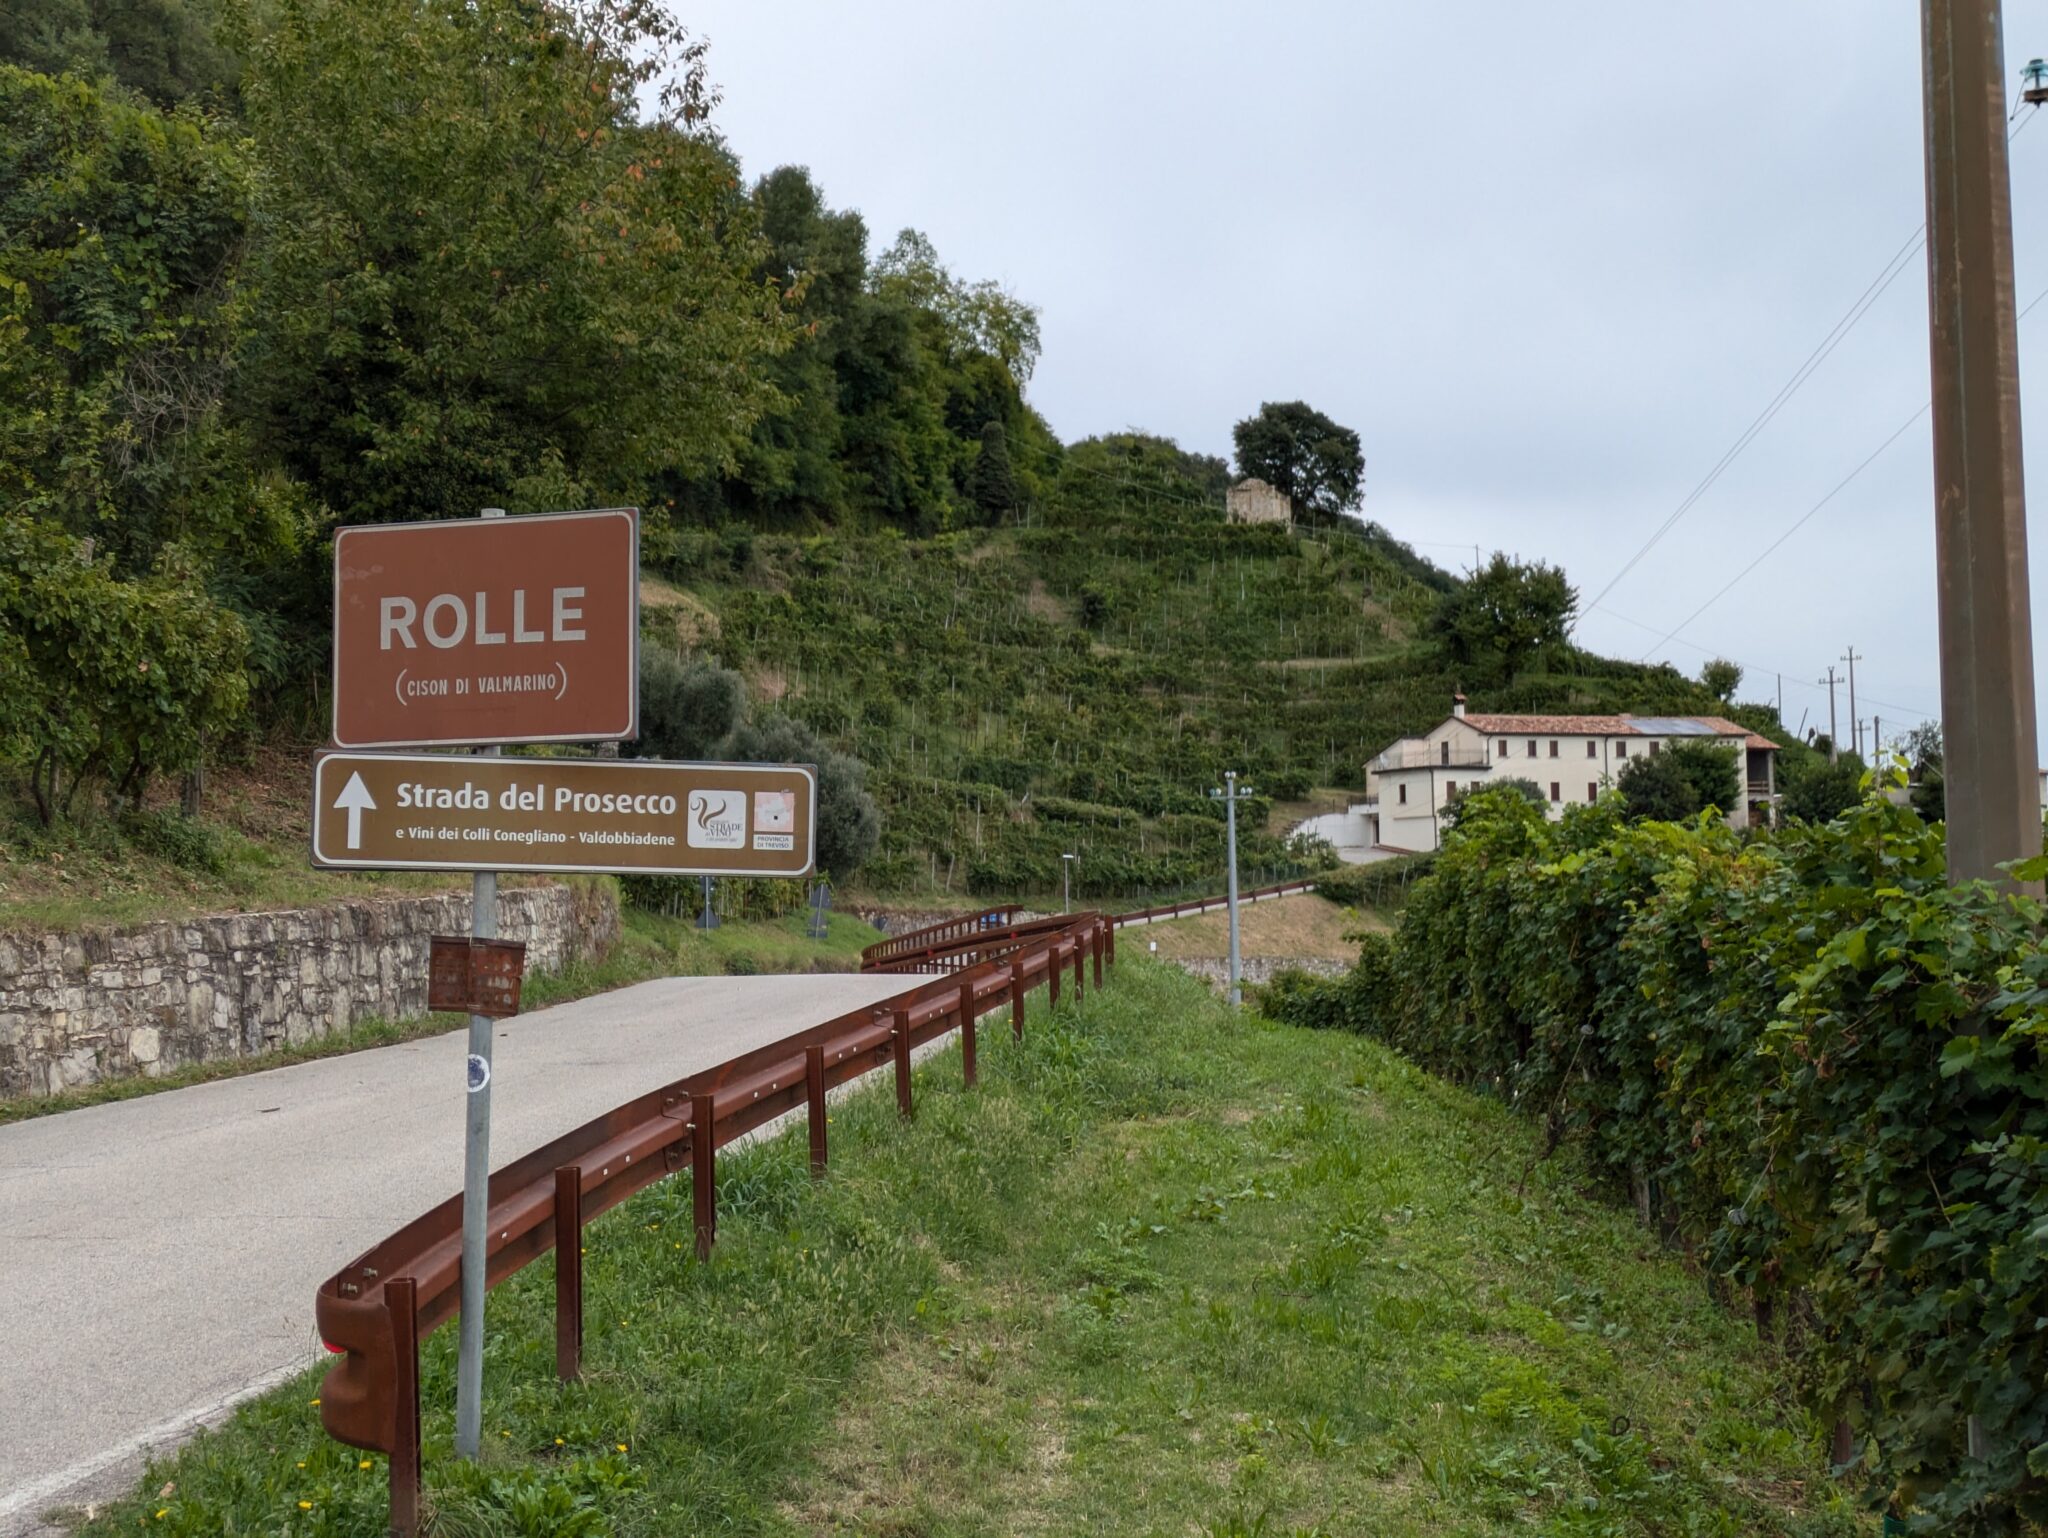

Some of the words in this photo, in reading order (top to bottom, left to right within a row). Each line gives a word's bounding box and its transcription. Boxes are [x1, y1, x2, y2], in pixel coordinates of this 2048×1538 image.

[380, 587, 586, 650] ROLLE
[455, 678, 469, 694] DI
[396, 782, 489, 809] Strada
[499, 783, 544, 811] del
[554, 788, 677, 815] Prosecco
[395, 828, 404, 839] e
[408, 827, 434, 840] Vini
[438, 827, 459, 840] dei
[462, 828, 490, 841] Colli
[493, 829, 566, 845] Conegliano
[578, 831, 675, 846] Valdobbiadene
